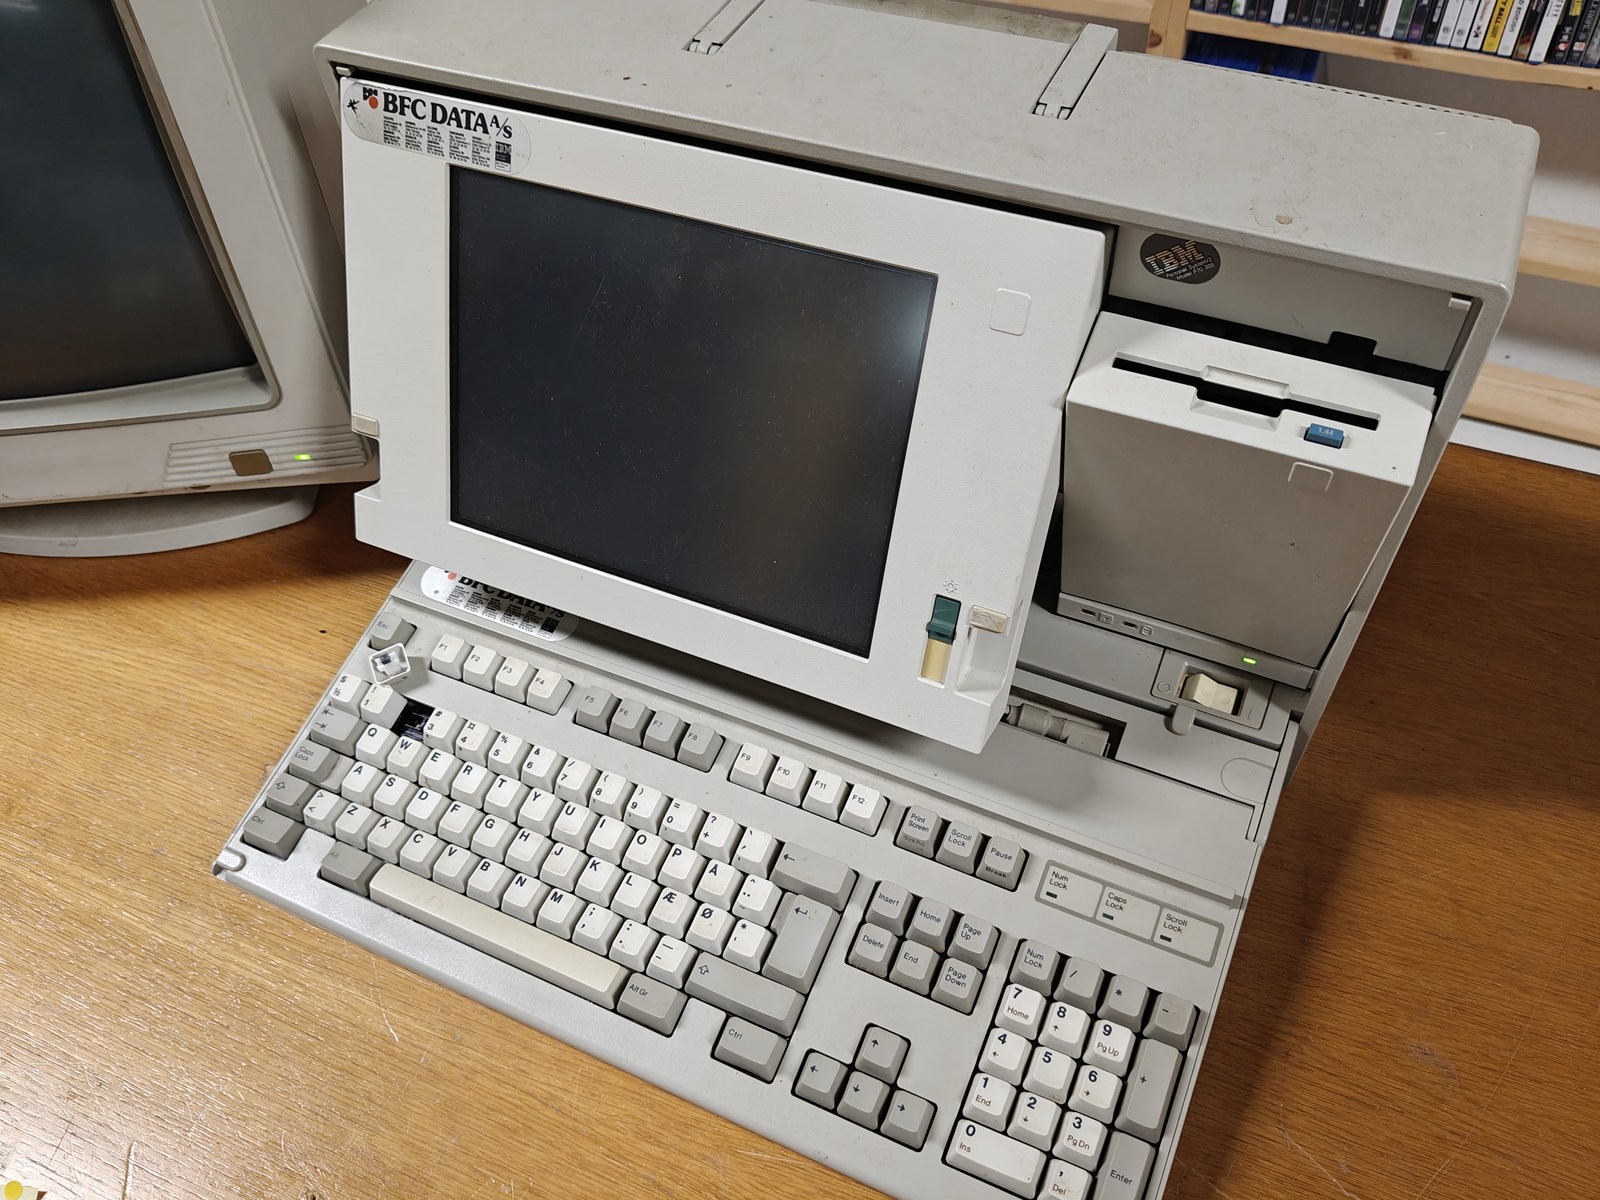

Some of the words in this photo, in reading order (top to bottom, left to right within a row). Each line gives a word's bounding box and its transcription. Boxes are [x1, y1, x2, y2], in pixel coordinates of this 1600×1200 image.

[1495, 7, 1505, 24] BALL
[383, 91, 426, 121] BFC
[430, 102, 490, 134] DATA
[490, 114, 513, 139] A/S
[496, 142, 511, 155] IBM
[1144, 240, 1204, 275] IBM
[1318, 427, 1334, 436] 1.44
[377, 620, 389, 630] Esc
[439, 642, 448, 650] F1
[471, 654, 481, 662] F2
[502, 665, 512, 674] F3
[536, 677, 545, 686] F4
[584, 695, 595, 703] F5
[618, 708, 629, 716] F6
[652, 720, 663, 728] F7
[368, 728, 378, 738] Q
[688, 732, 698, 741] F8
[400, 739, 412, 750] W
[300, 746, 314, 756] Caps
[295, 753, 309, 762] Lock
[430, 752, 441, 763] E
[354, 766, 364, 776] A
[463, 765, 473, 775] R
[777, 766, 790, 776] F10
[386, 778, 396, 787] S
[498, 778, 508, 788] T
[814, 780, 827, 790] F11
[418, 790, 429, 801] D
[533, 792, 542, 801] Y
[852, 794, 865, 804] F12
[348, 805, 358, 815] Z
[450, 804, 461, 813] F
[565, 805, 576, 816] U
[252, 816, 265, 825] Ctrl
[380, 818, 391, 829] X
[484, 818, 496, 829] G
[910, 813, 926, 824] Print
[908, 820, 929, 833] Screen
[414, 834, 423, 844] C
[518, 830, 531, 842] H
[636, 834, 647, 845] O
[951, 829, 973, 842] Scroll
[948, 836, 966, 848] Lock
[448, 847, 458, 857] V
[554, 847, 565, 856] J
[672, 848, 682, 858] P
[990, 847, 1013, 861] Pause
[480, 861, 490, 872] B
[590, 860, 601, 871] K
[709, 864, 719, 876] Å
[986, 866, 1007, 879] Break
[1052, 871, 1069, 882] Num
[515, 876, 527, 887] N
[626, 875, 633, 886] L
[1050, 878, 1068, 890] Lock
[550, 891, 564, 904] M
[662, 892, 677, 903] Æ
[878, 892, 899, 907] Insert
[1108, 892, 1128, 905] Caps
[1106, 900, 1124, 912] Lock
[700, 908, 714, 919] Ø
[920, 910, 941, 924] Home
[1166, 914, 1188, 927] Scroll
[963, 924, 981, 936] Page
[1163, 922, 1183, 933] Lock
[862, 935, 885, 949] Delete
[960, 932, 971, 941] Up
[904, 952, 918, 964] End
[1026, 948, 1044, 961] Num
[1024, 958, 1043, 969] Lock
[948, 966, 967, 980] Page
[945, 974, 966, 988] Down
[629, 984, 639, 993] Alt
[639, 988, 649, 997] Gr
[1013, 988, 1023, 999] 7
[1007, 1006, 1030, 1021] Home
[1056, 1006, 1067, 1019] 8
[728, 1028, 743, 1040] Ctrl
[1102, 1024, 1113, 1036] 9
[998, 1034, 1007, 1045] 4
[1042, 1052, 1052, 1064] 5
[1088, 1070, 1098, 1083] 6
[982, 1077, 990, 1089] 1
[976, 1095, 991, 1107] End
[1026, 1097, 1037, 1110] 2
[1072, 1116, 1083, 1129] 3
[966, 1124, 976, 1137] 0
[960, 1142, 971, 1153] Ins
[1110, 1170, 1133, 1186] Enter
[1052, 1184, 1067, 1196] Del
